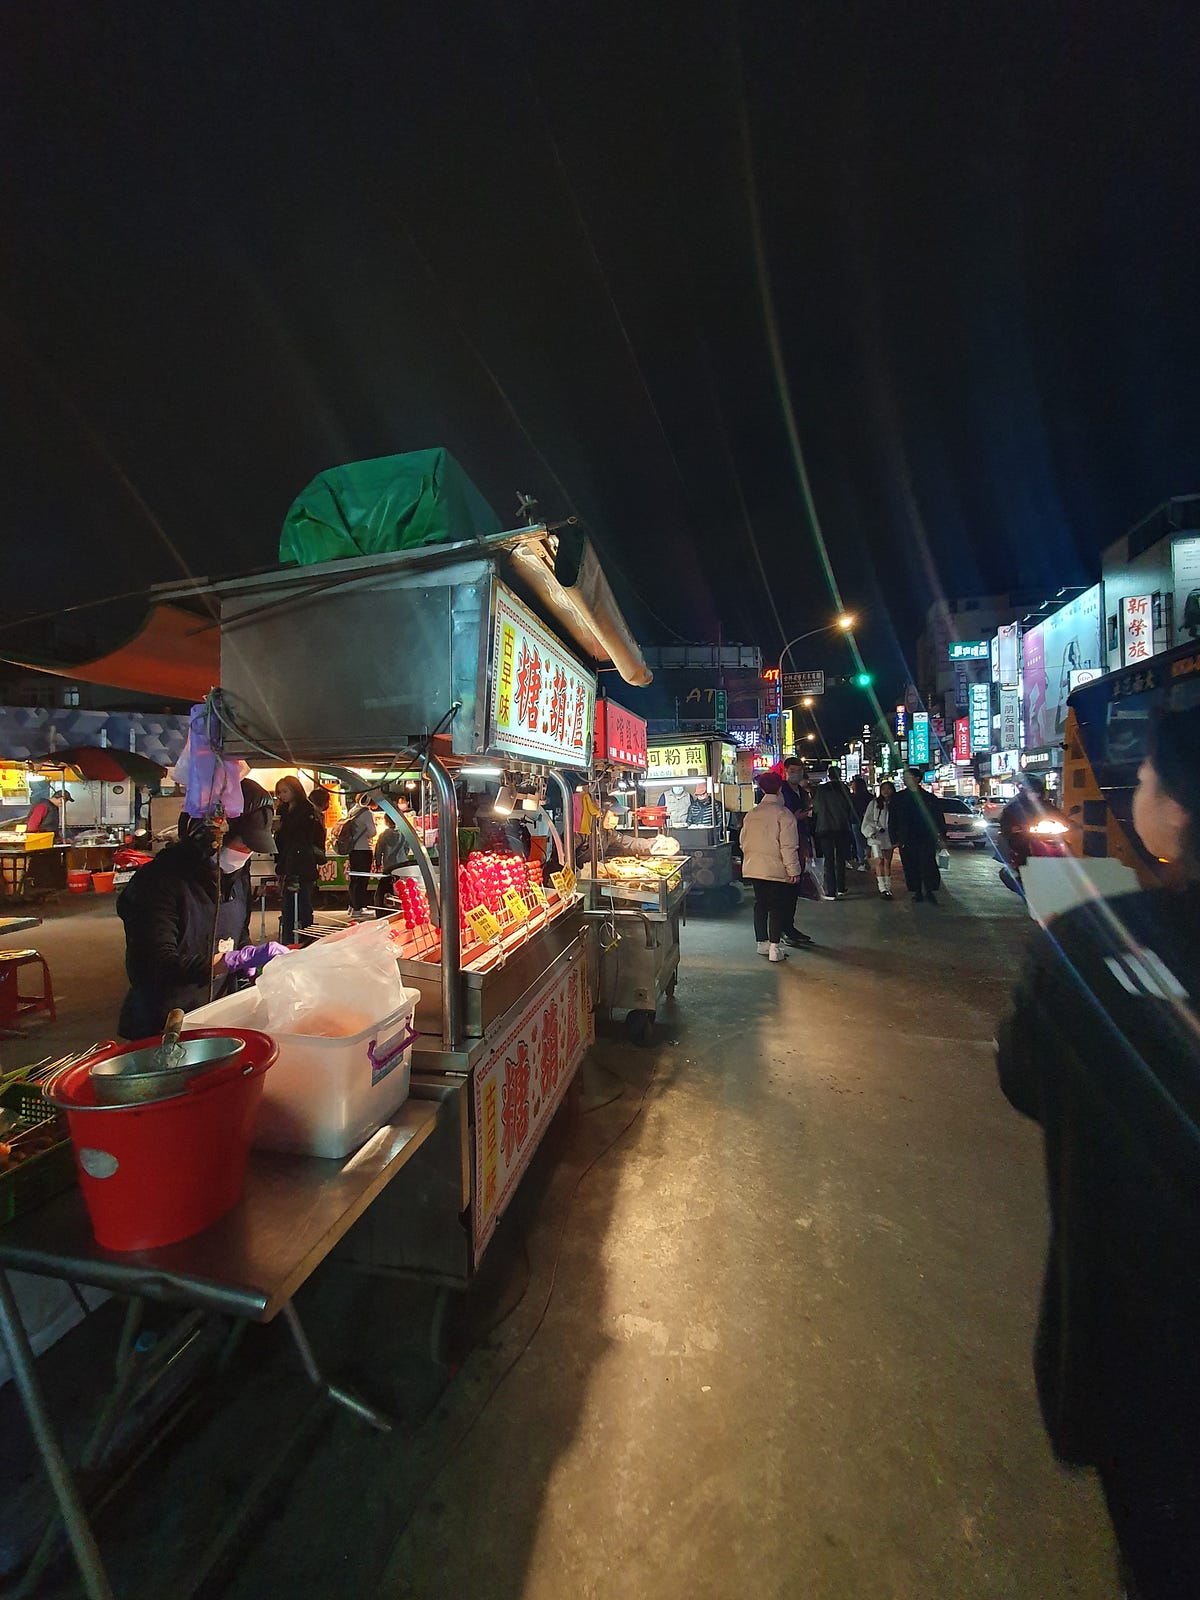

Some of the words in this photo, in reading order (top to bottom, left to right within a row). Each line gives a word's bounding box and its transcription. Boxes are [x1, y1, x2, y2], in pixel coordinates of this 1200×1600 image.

[1127, 597, 1150, 658] 新榮旅
[498, 628, 514, 726] 古早味
[514, 636, 586, 750] 糖葫蘆
